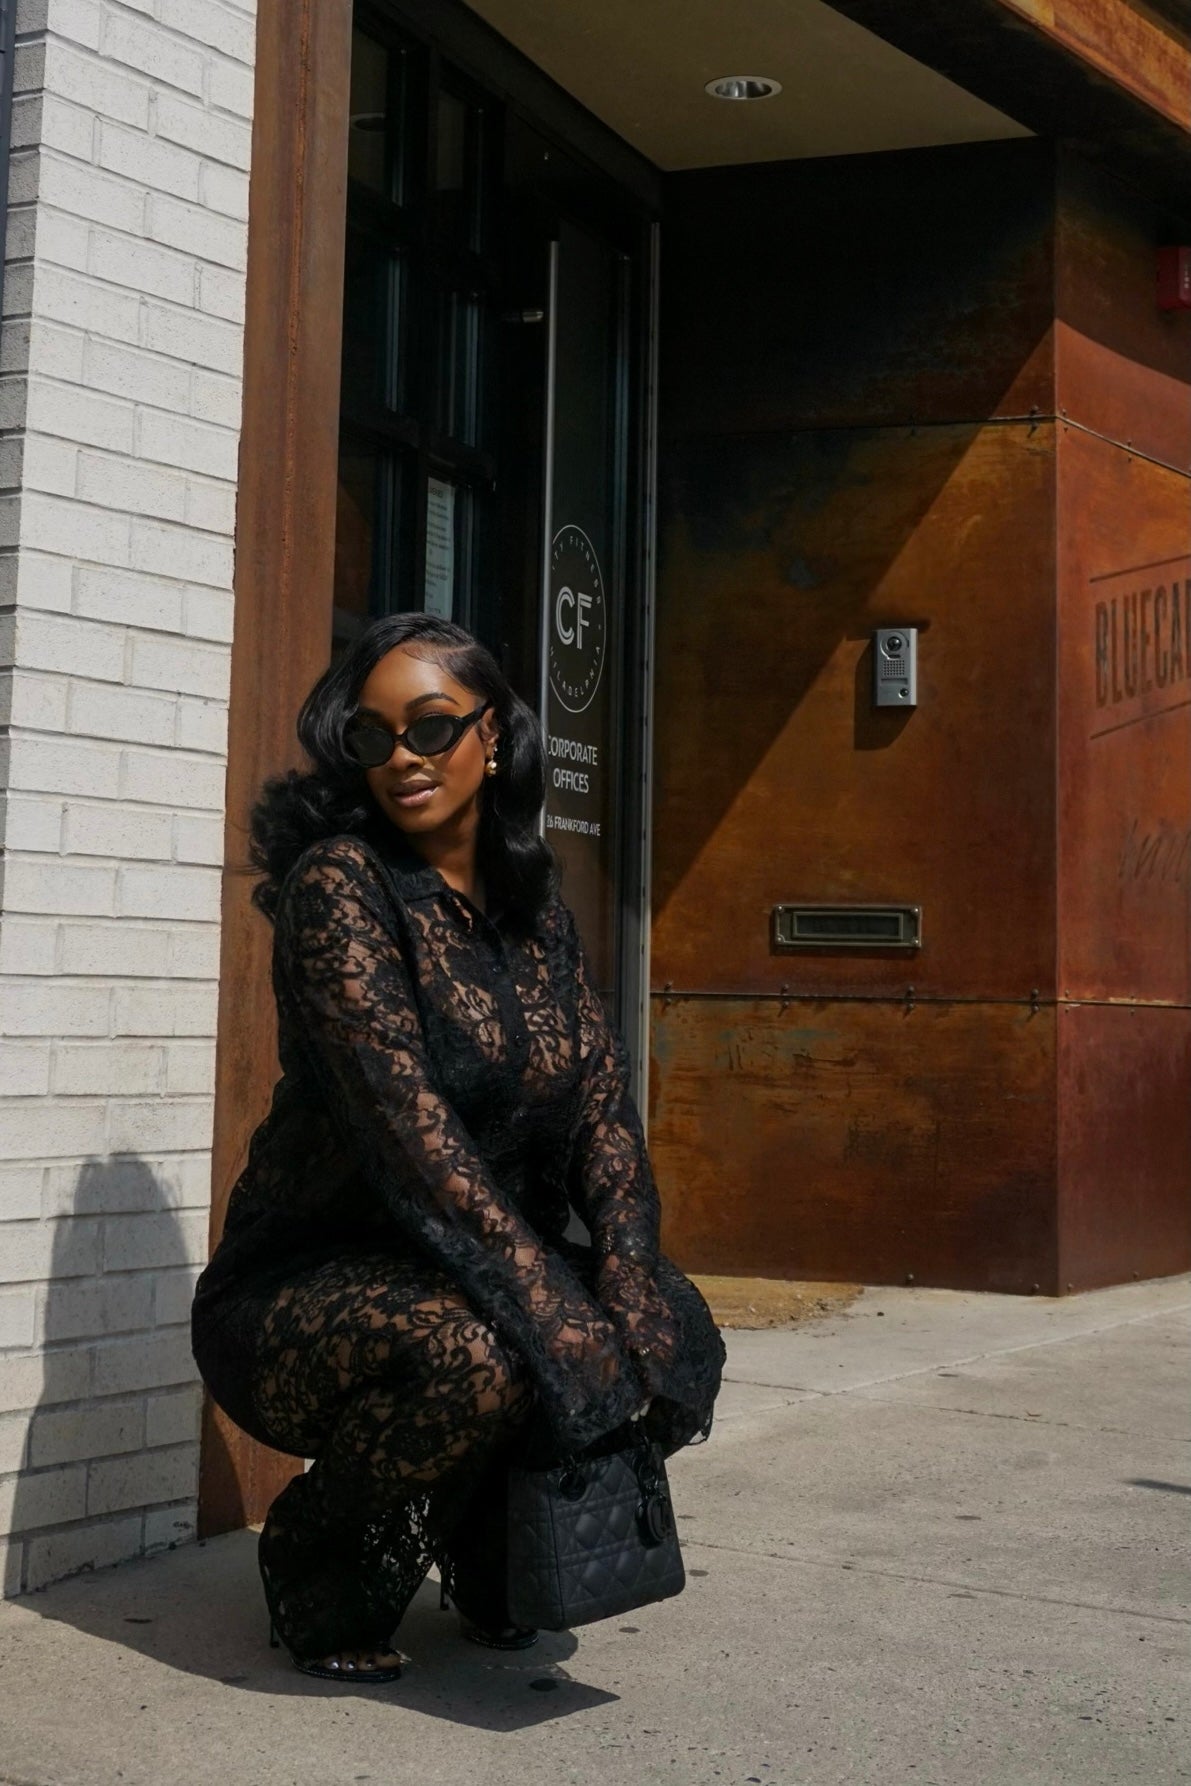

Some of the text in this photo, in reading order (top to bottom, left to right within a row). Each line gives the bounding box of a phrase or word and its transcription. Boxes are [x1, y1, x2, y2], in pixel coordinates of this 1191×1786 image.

[569, 535, 601, 605] FITNESS
[556, 586, 593, 650] CF
[550, 645, 601, 698] HILADELPHIA
[548, 735, 598, 766] ORPORATE
[553, 768, 590, 793] OFFICES
[554, 816, 589, 834] FRANKFORD
[589, 823, 601, 837] AVE
